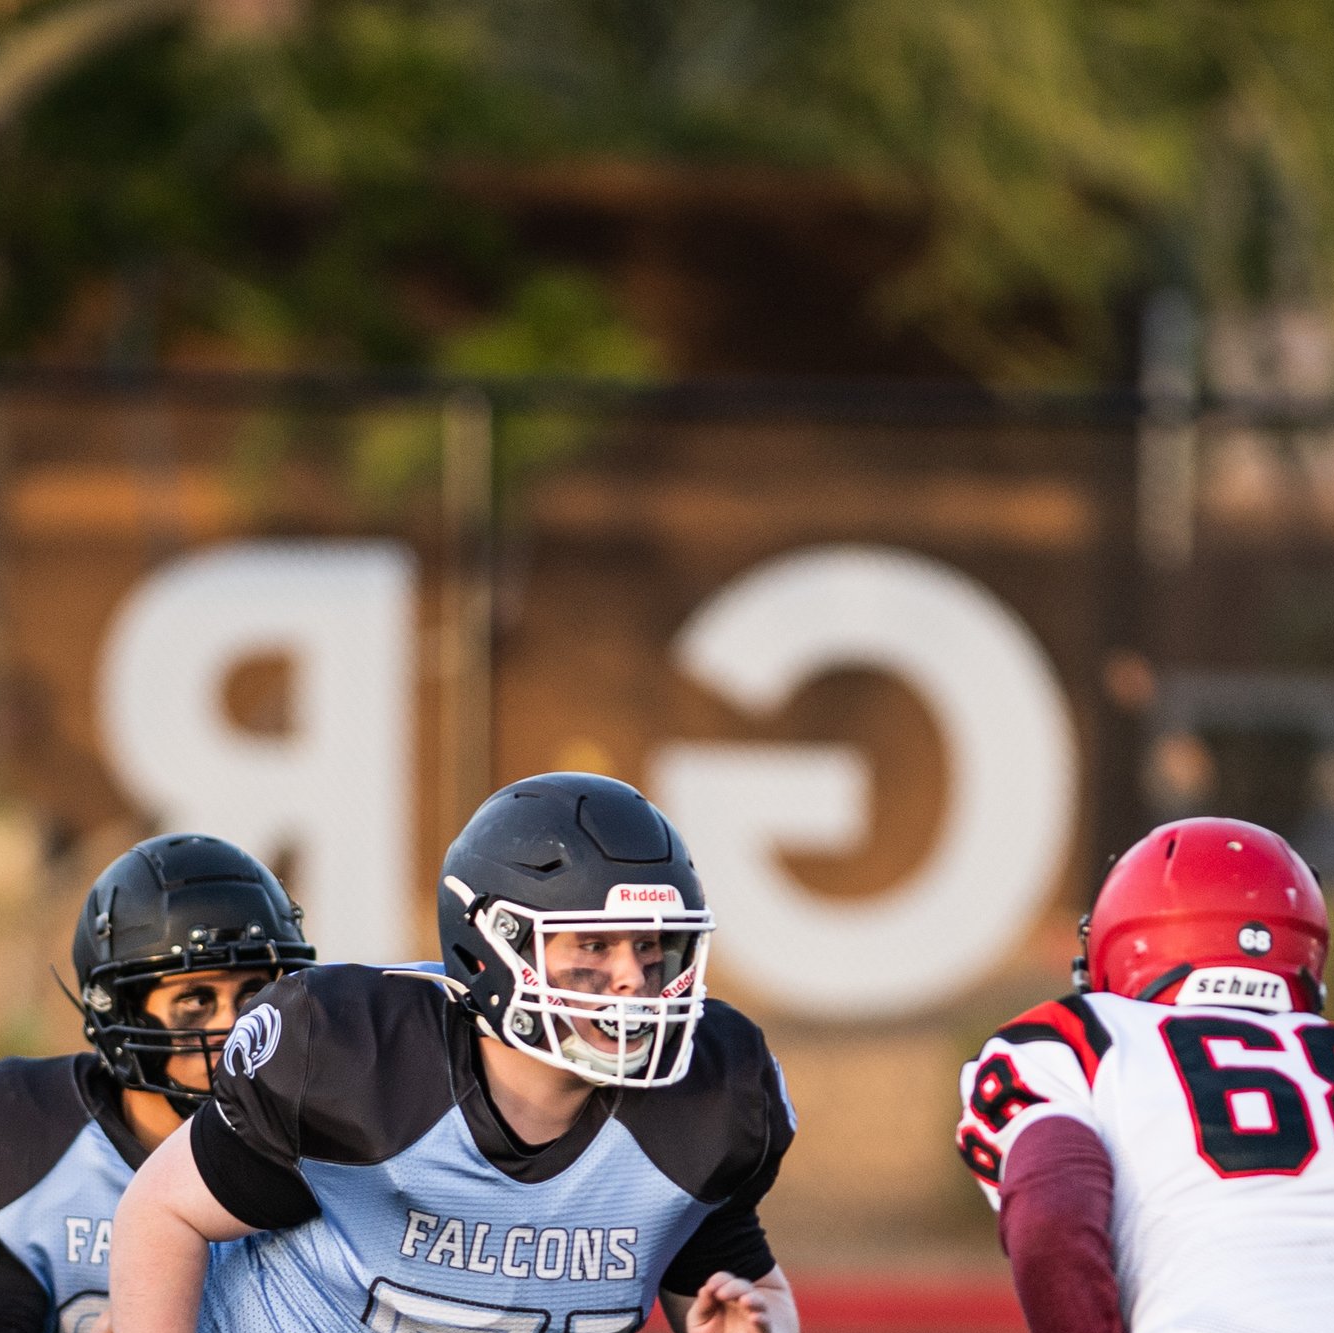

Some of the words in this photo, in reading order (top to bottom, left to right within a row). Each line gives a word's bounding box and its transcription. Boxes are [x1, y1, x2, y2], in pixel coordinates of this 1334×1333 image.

[620, 889, 676, 902] Riddell
[1238, 928, 1272, 953] 68
[1197, 975, 1280, 999] schutt
[400, 1209, 638, 1281] FALCONS
